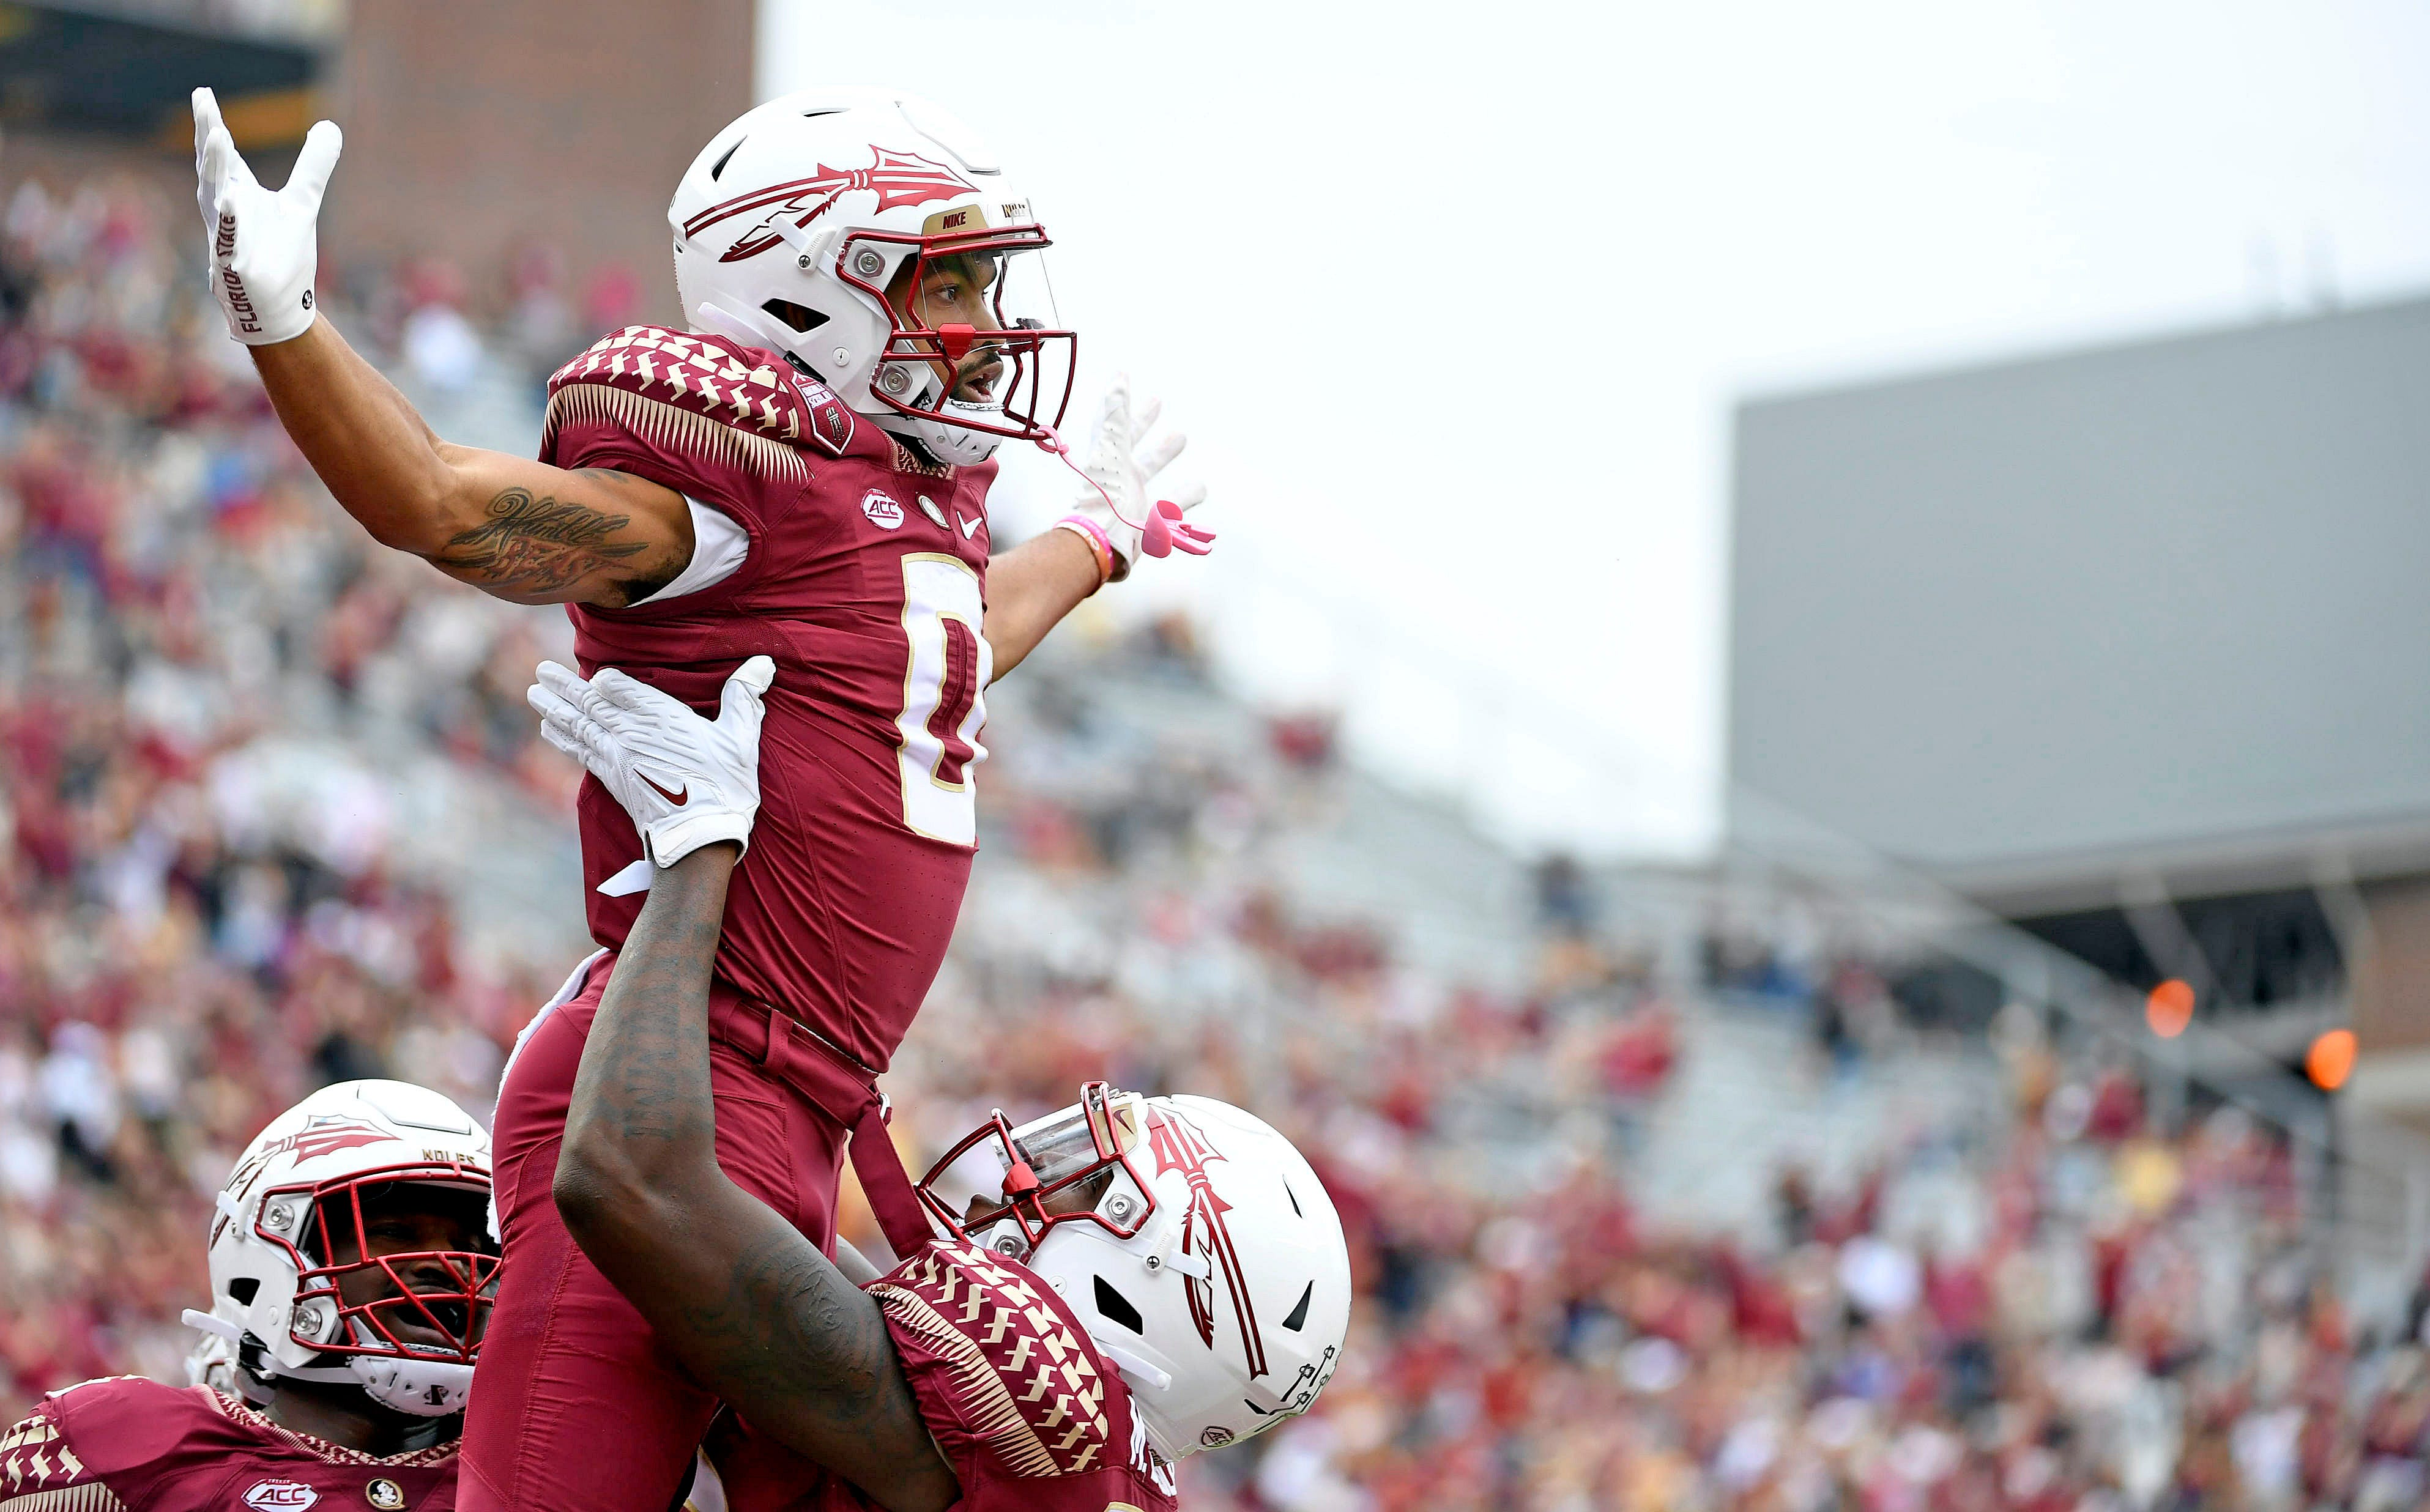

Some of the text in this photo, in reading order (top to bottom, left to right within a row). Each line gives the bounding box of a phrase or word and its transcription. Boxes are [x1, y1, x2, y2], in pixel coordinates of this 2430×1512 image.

[943, 211, 967, 230] NIKE
[217, 212, 262, 333] FLORIDA STATE
[869, 500, 898, 516] ACC
[894, 551, 993, 847] 0
[256, 1486, 307, 1502] ACC
